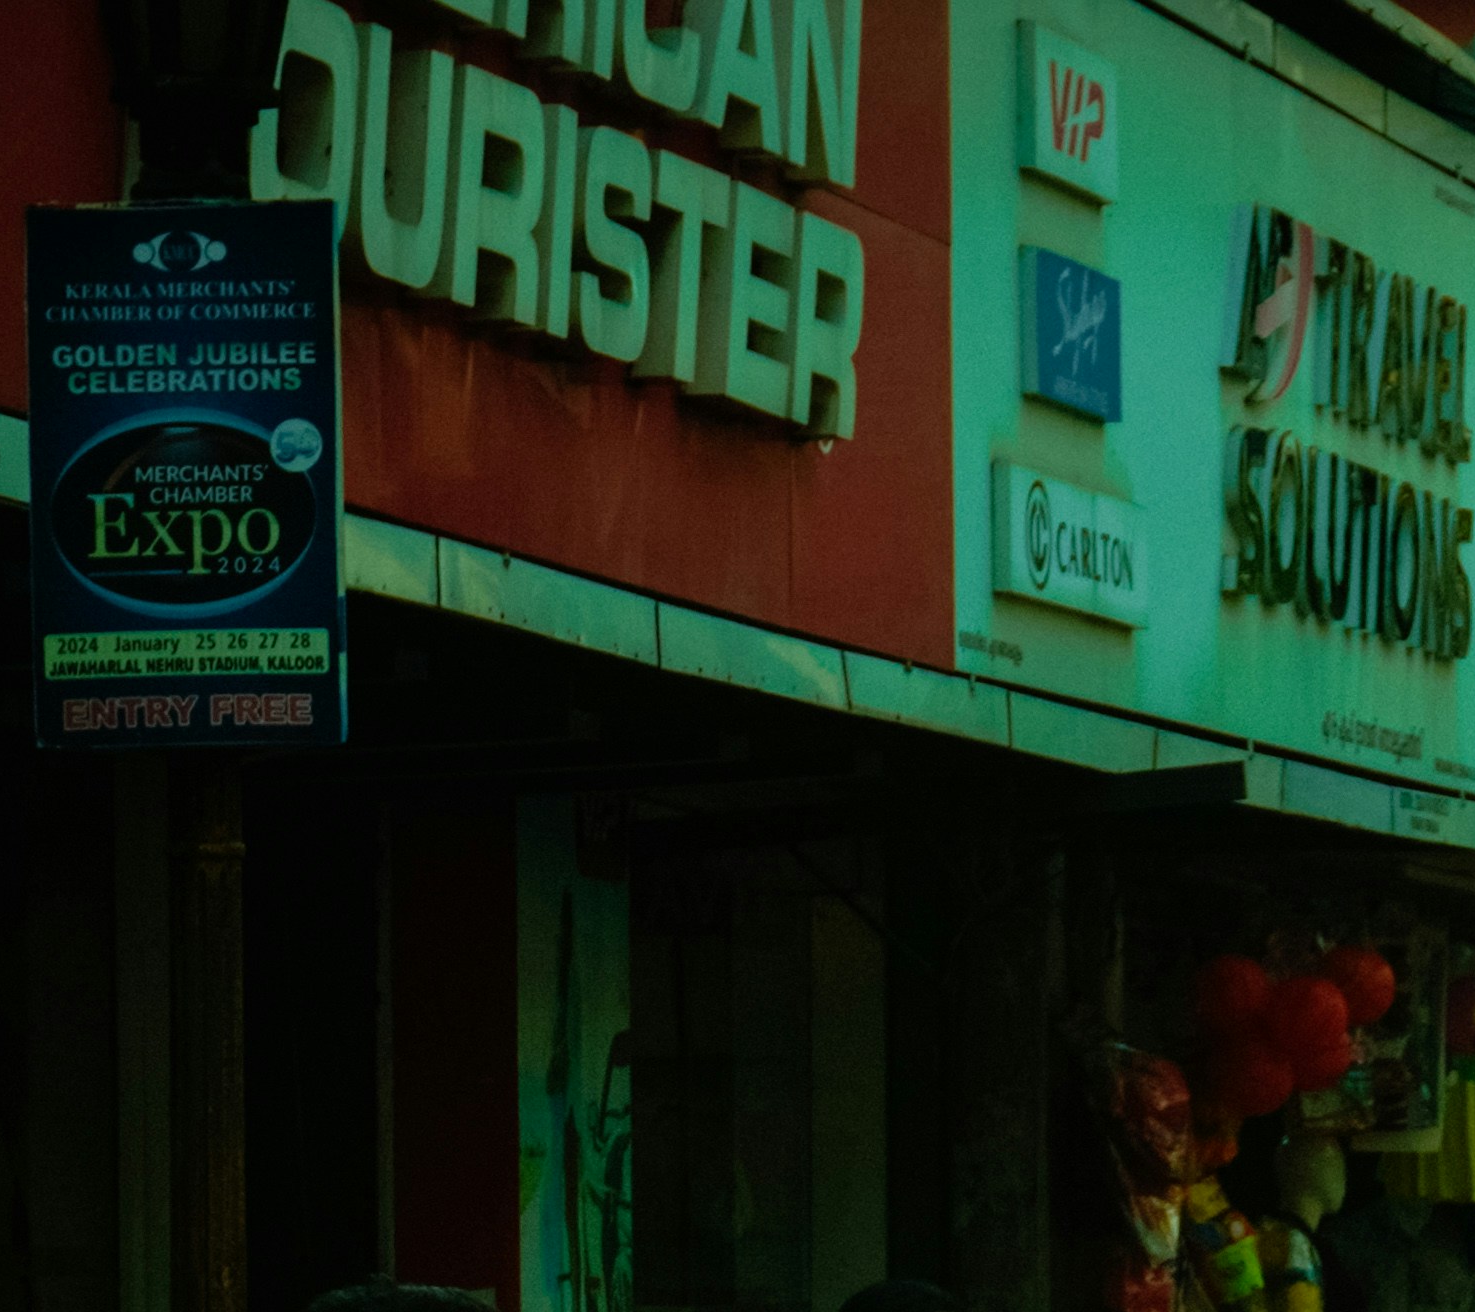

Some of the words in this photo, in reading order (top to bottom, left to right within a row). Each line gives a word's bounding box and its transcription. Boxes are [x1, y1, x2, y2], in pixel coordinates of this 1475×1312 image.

[1048, 59, 1105, 163] VIP
[249, 0, 864, 441] OURISTER
[64, 282, 153, 300] KERALA
[156, 279, 296, 299] MERCHANTS'
[45, 304, 151, 322] CHAMBER
[157, 303, 184, 321] OF
[189, 301, 317, 321] COMMERCE
[52, 343, 177, 369] GOLDEN
[187, 342, 317, 366] JUBILEE
[67, 367, 302, 395] CELEBRATIONS
[134, 463, 269, 483] MERCHANTS'
[149, 485, 253, 505] CHAMBER
[86, 491, 281, 575] Expo
[217, 556, 282, 575] 2024
[1057, 520, 1134, 592] CARLTON
[57, 637, 99, 655] 2024
[114, 634, 180, 656] January
[196, 633, 216, 650] 25
[227, 632, 248, 650] 26
[259, 632, 279, 649] 27
[289, 631, 310, 648] 28
[50, 657, 142, 677] JAWAHARLAL
[146, 656, 194, 674] NEHRU
[198, 655, 264, 674] STADIUM,
[267, 654, 325, 672] KALOOR
[62, 694, 199, 732] ENTRY
[210, 693, 314, 727] FREE
